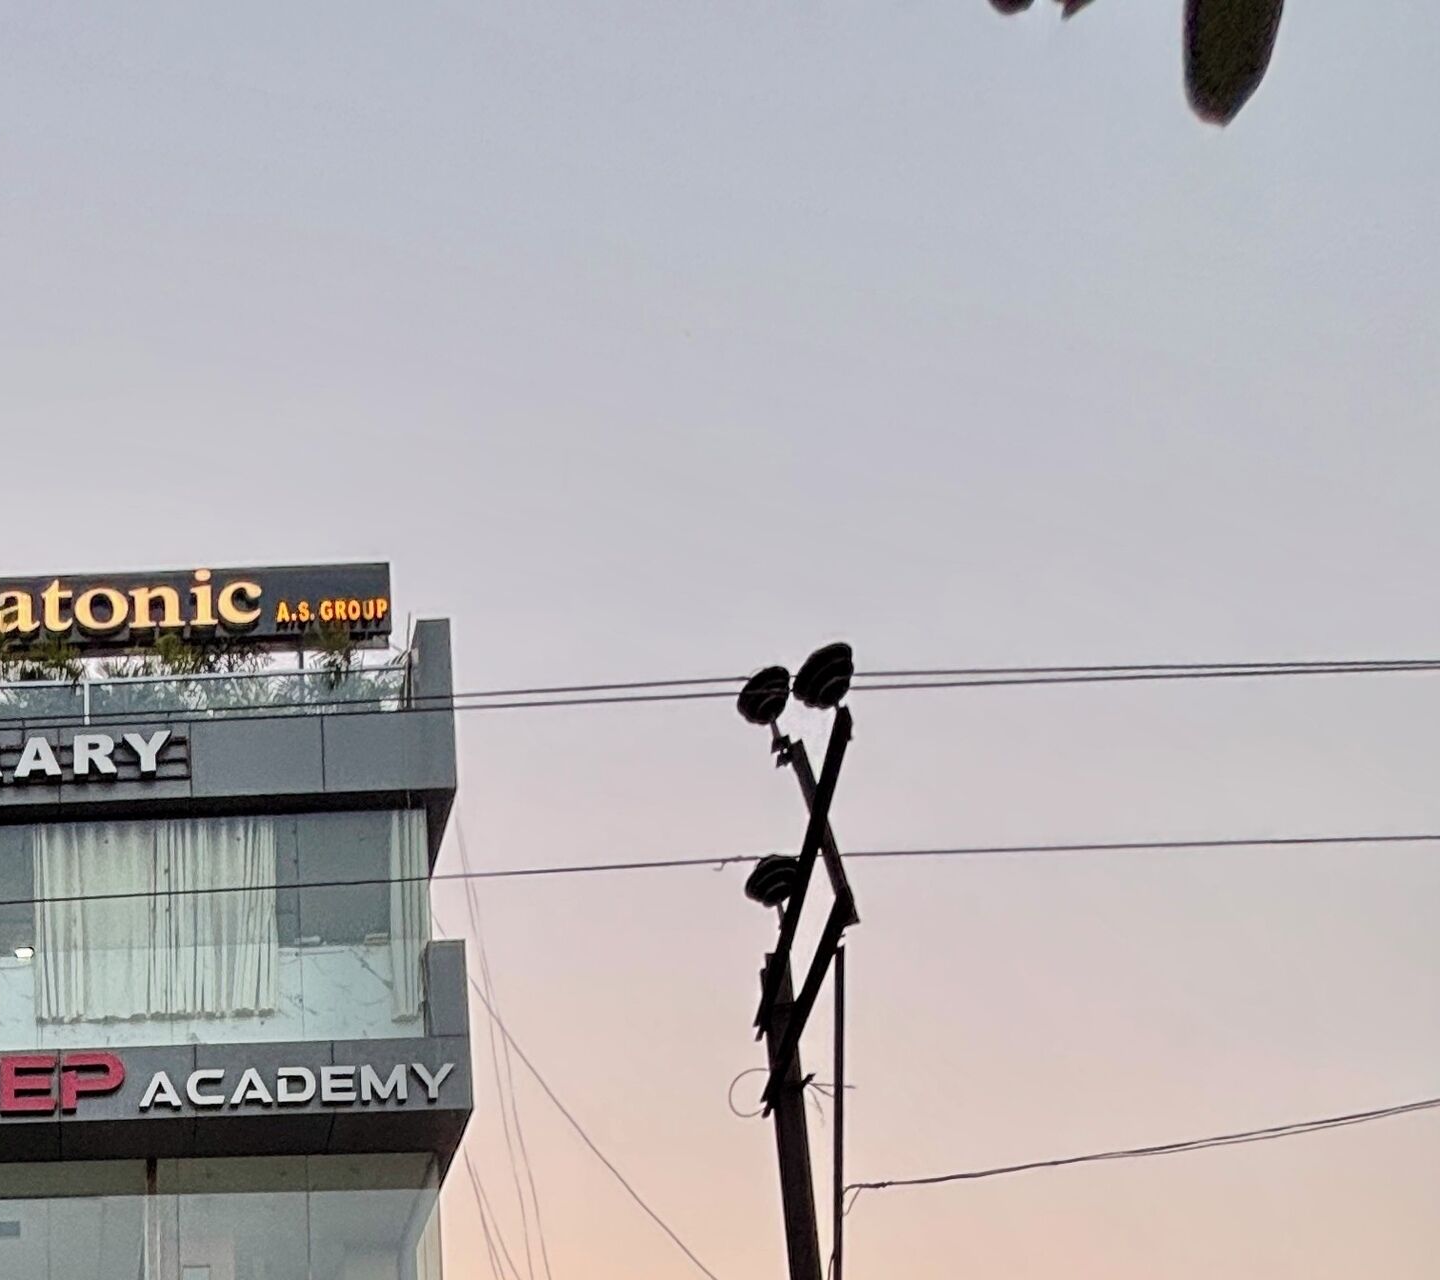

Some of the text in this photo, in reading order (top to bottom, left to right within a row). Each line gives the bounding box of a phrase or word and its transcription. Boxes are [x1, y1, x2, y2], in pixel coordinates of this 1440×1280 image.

[276, 600, 316, 623] A.S.
[320, 597, 389, 621] GROUP
[138, 1062, 458, 1111] ACADEMY
